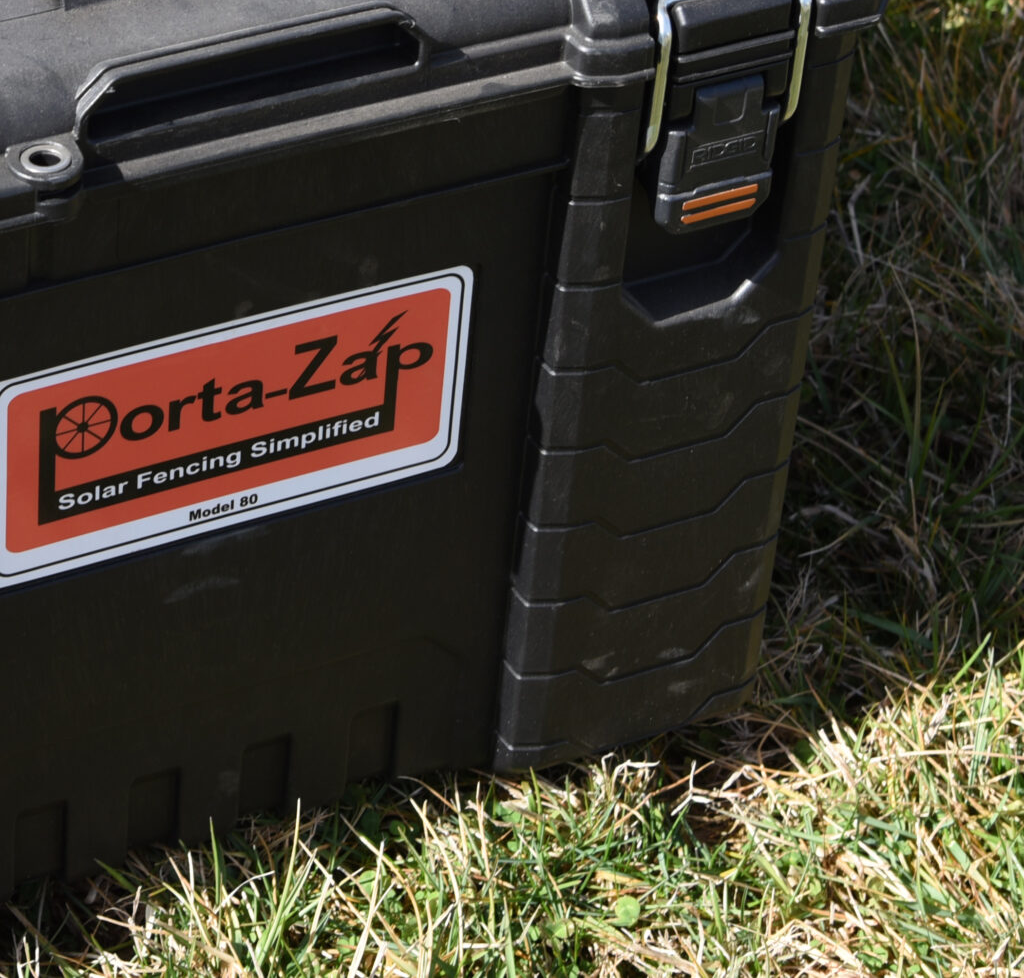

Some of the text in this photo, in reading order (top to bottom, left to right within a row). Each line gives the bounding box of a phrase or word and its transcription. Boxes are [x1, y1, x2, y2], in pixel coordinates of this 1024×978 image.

[58, 411, 380, 510] Solar Fencing Simplified
[188, 493, 259, 522] Model 80
